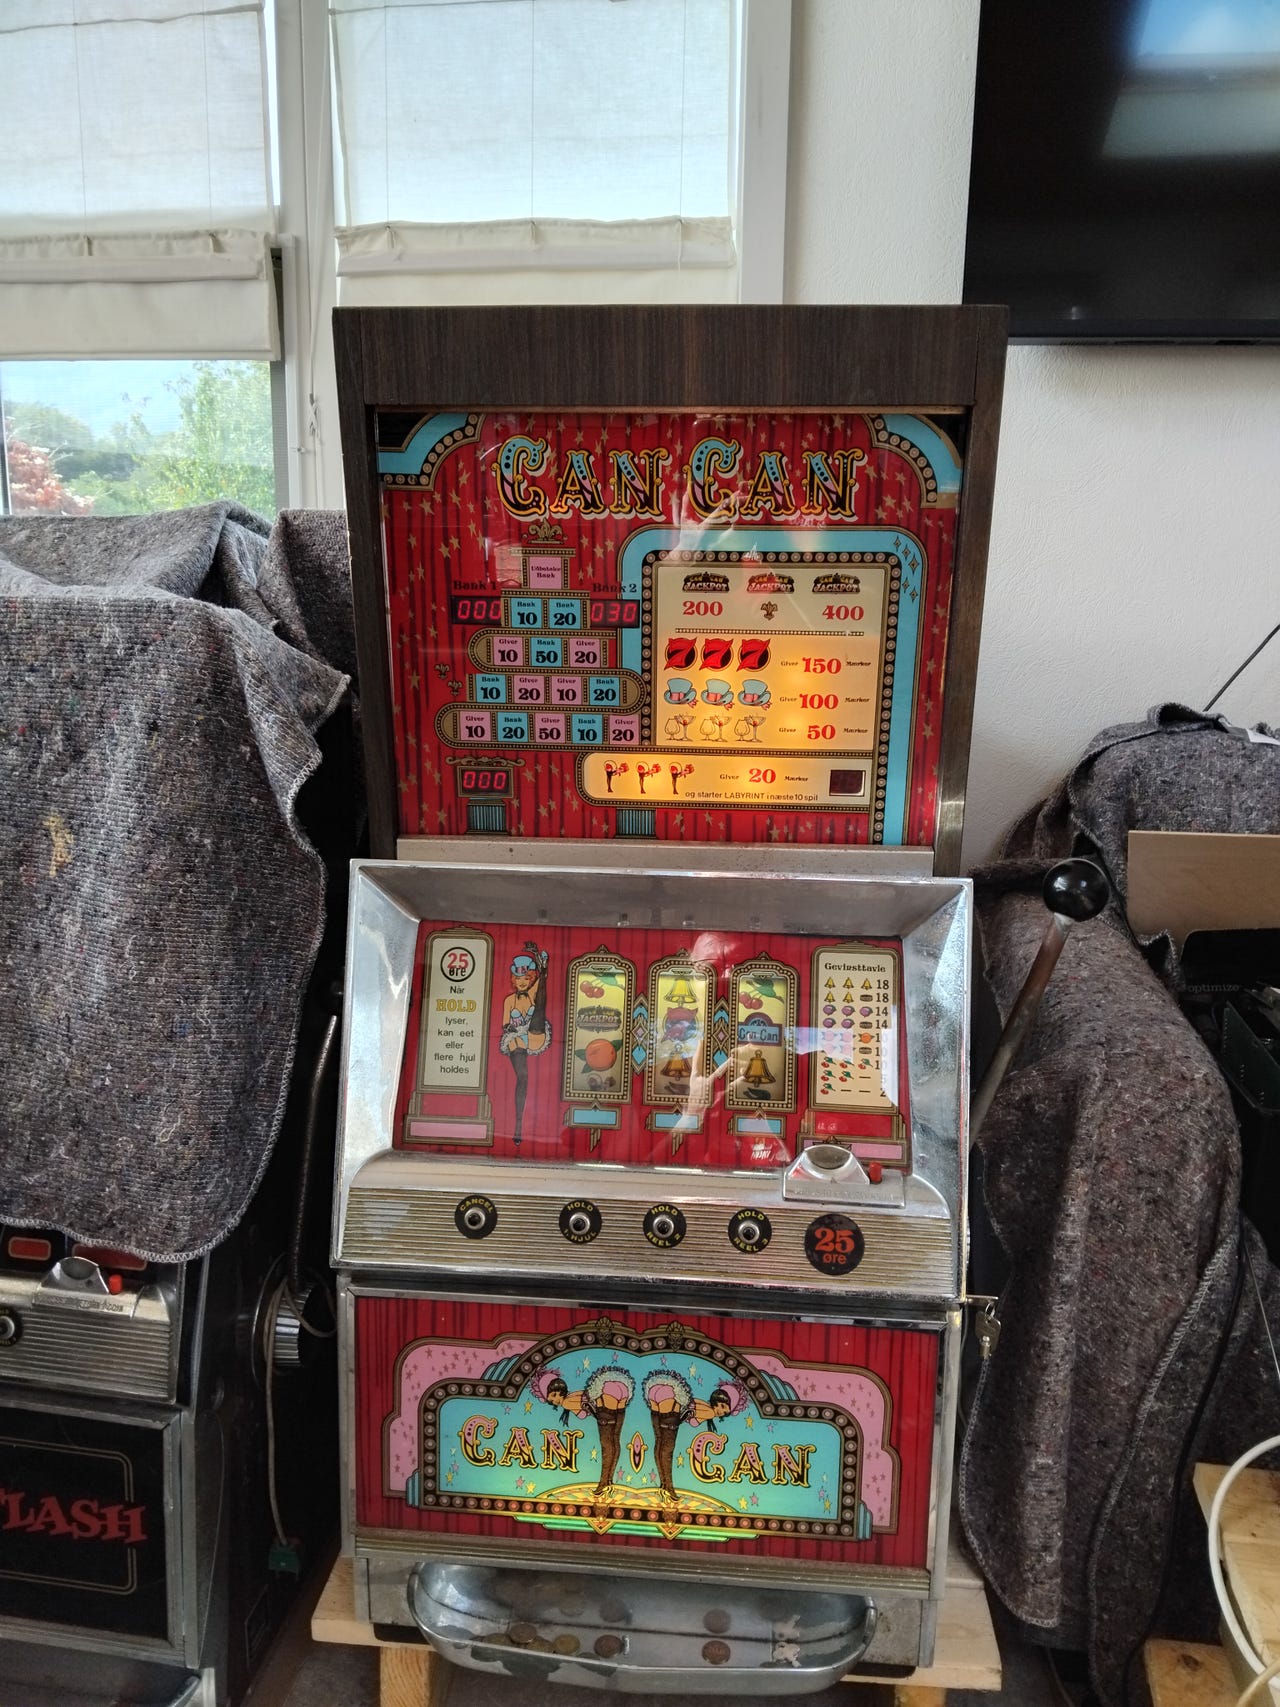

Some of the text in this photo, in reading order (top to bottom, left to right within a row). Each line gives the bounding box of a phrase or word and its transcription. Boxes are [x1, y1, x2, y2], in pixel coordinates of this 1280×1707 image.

[492, 435, 870, 521] CAN CAN
[454, 580, 496, 590] Bank 1
[592, 583, 637, 592] Bank 2
[684, 582, 727, 591] JACKPOT
[748, 582, 792, 592] JACKPOT
[814, 584, 858, 592] JACKPOT
[591, 603, 637, 622] 030
[683, 601, 723, 616] 200
[822, 605, 864, 620] 400
[518, 612, 538, 626] 10
[554, 613, 576, 626] 20
[499, 650, 518, 663] 10
[536, 651, 558, 663] 50
[574, 651, 597, 664] 20
[802, 657, 841, 674] 150
[480, 687, 501, 700] 10
[518, 688, 540, 701] 20
[557, 688, 576, 701] 10
[593, 688, 616, 702] 20
[800, 694, 839, 709] 100
[466, 726, 485, 738] 10
[502, 726, 525, 739] 20
[539, 727, 561, 740] 50
[578, 729, 597, 742] 10
[612, 729, 634, 742] 20
[807, 725, 835, 740] 50
[463, 771, 506, 789] 000
[749, 768, 776, 783] 20
[804, 794, 818, 802] spil
[447, 953, 468, 968] 25
[824, 962, 886, 972] Gevinsttavle
[876, 980, 889, 989] 18
[876, 993, 888, 1002] 18
[436, 998, 477, 1012] HOLD
[875, 1007, 888, 1016] 14
[576, 1014, 619, 1023] JACKPOT
[875, 1019, 888, 1028] 14
[438, 1029, 454, 1037] kan
[445, 1041, 464, 1049] eller
[434, 1053, 475, 1063] flere hjul
[440, 1065, 469, 1074] holdes
[460, 1199, 493, 1213] CANCEL
[567, 1200, 593, 1212] HOLD
[651, 1205, 678, 1216] HOLD
[738, 1211, 764, 1220] HOLD
[571, 1231, 596, 1241] HJUL
[647, 1232, 671, 1246] REEL
[815, 1227, 855, 1253] 25
[734, 1237, 759, 1252] REEL
[823, 1253, 846, 1264] øre
[458, 1415, 816, 1488] CAN CAN
[0, 1488, 147, 1544] LASH
